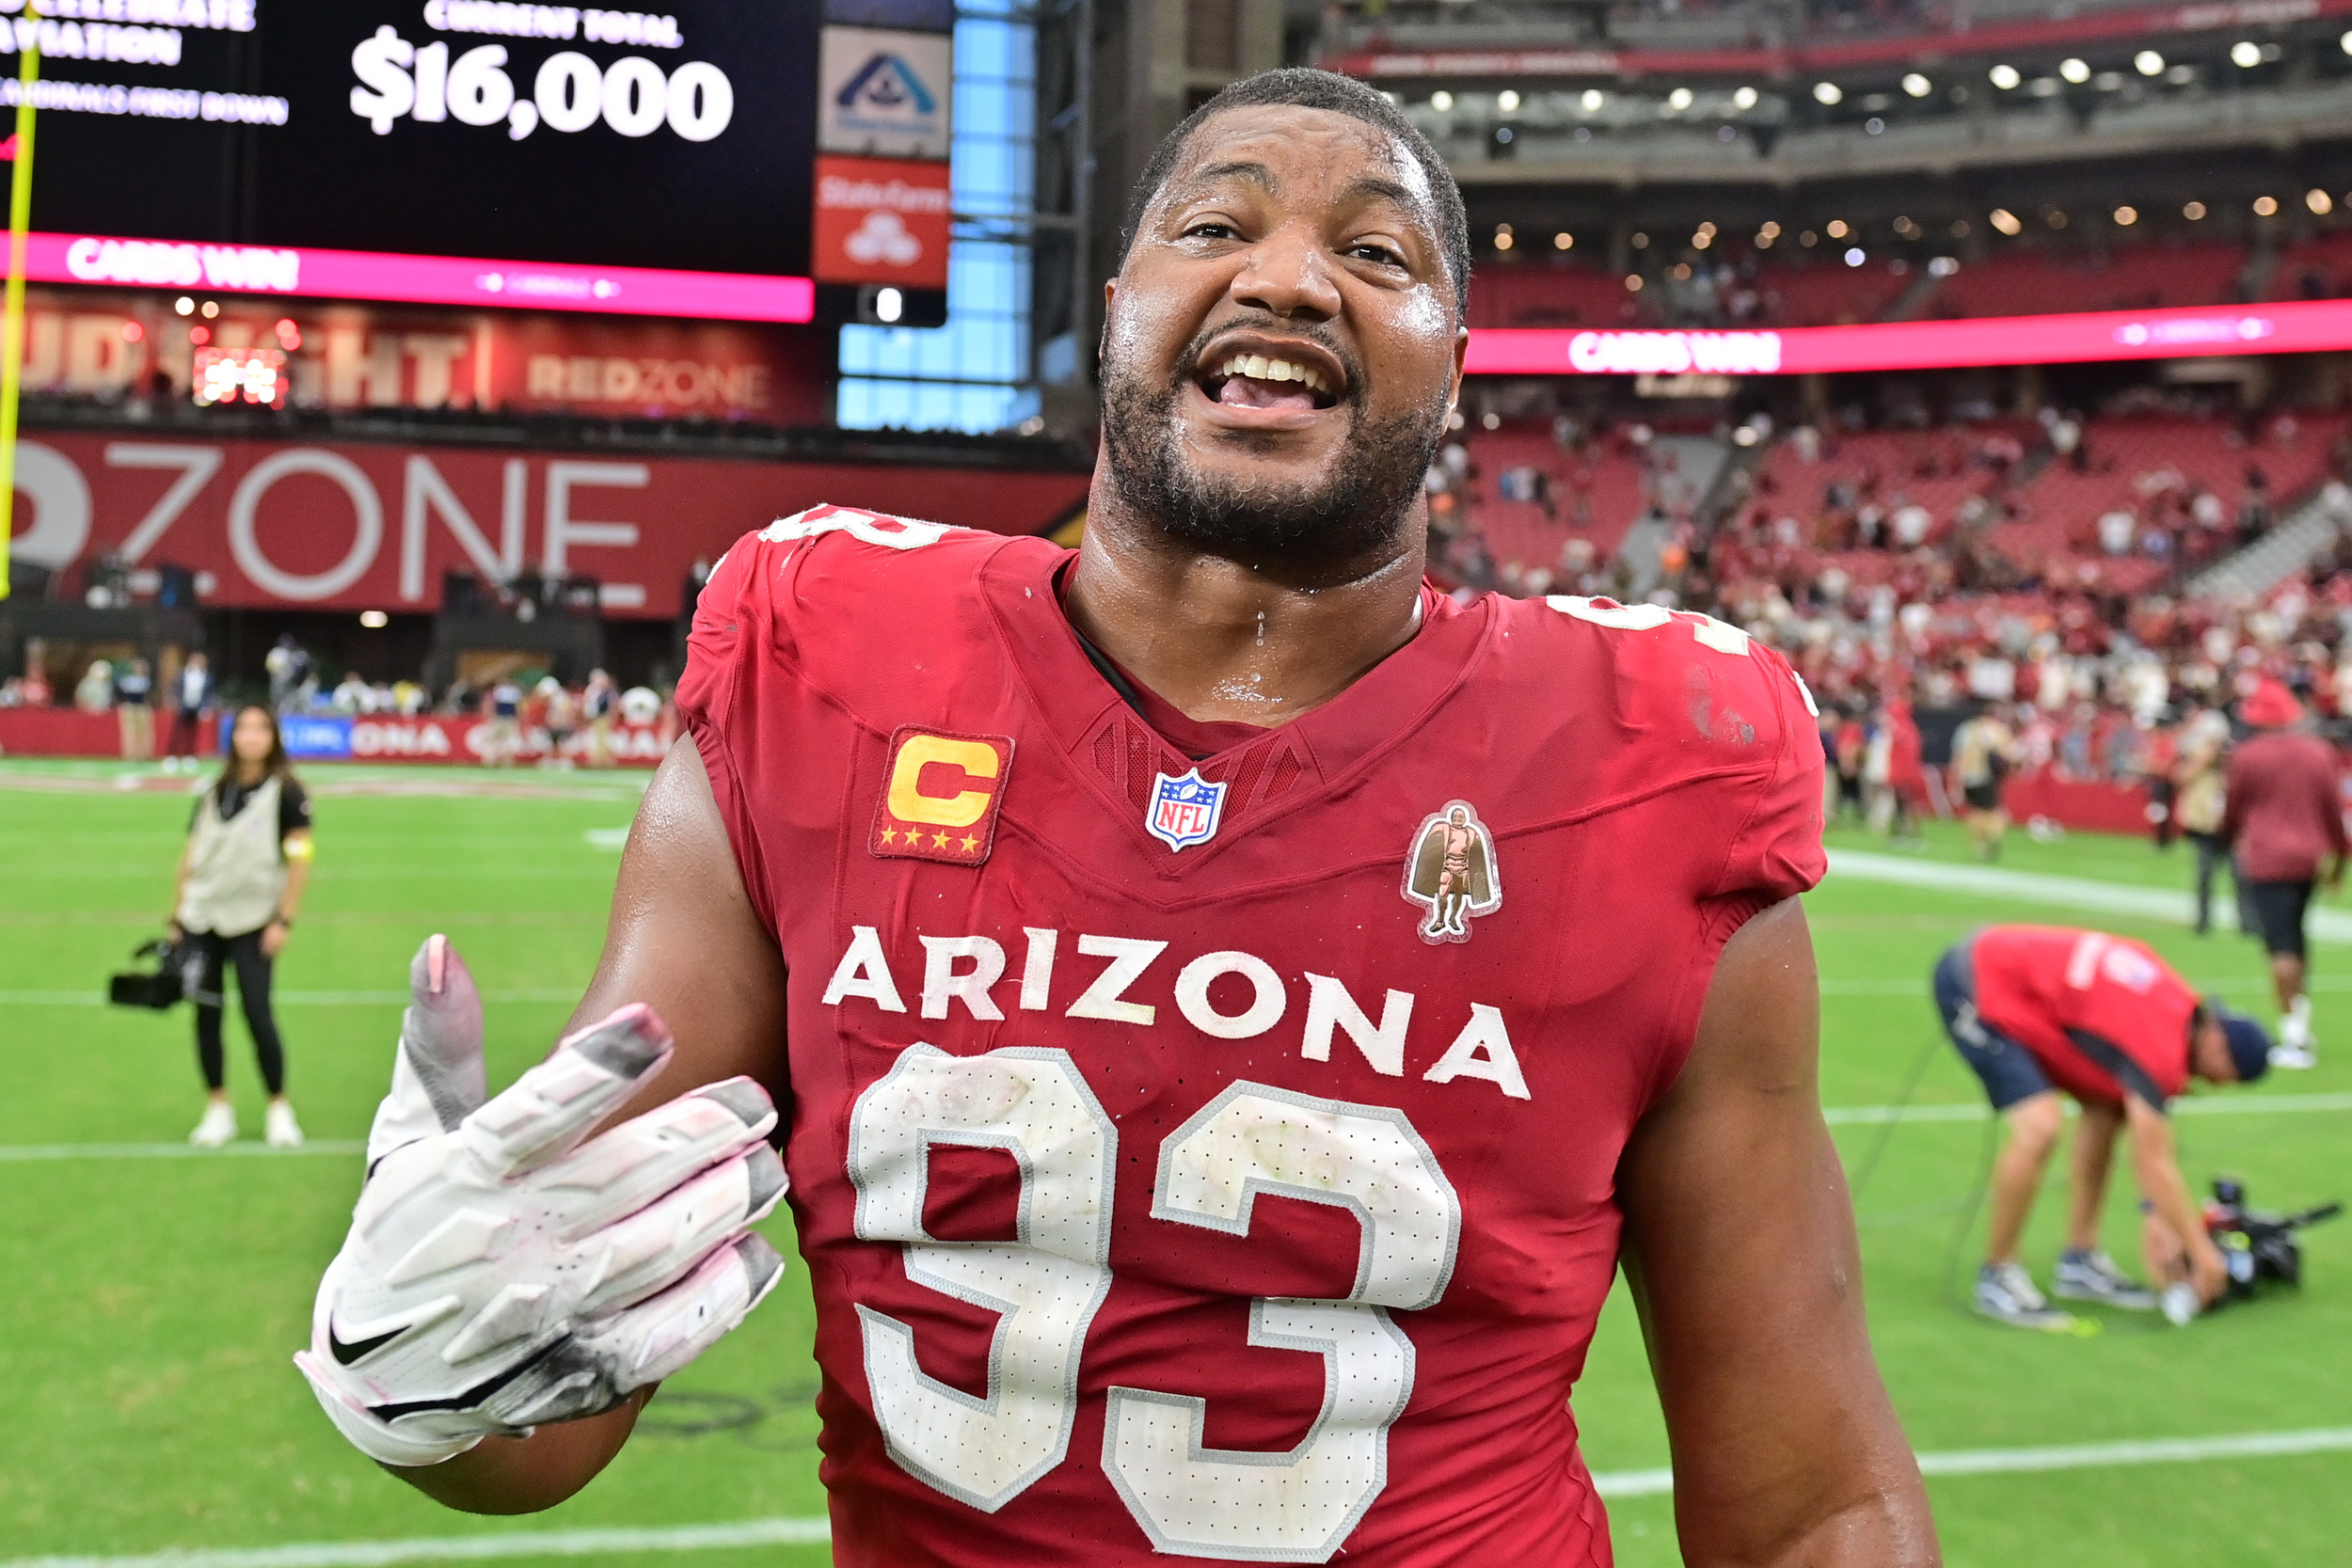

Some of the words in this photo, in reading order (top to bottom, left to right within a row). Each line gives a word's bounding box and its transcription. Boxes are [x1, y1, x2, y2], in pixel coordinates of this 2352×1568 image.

[423, 0, 577, 40] CURRENT
[583, 8, 685, 49] TOTAL
[350, 24, 734, 142] $16,000
[66, 237, 203, 286] CARDS
[162, 310, 469, 408] LHT
[1567, 331, 1692, 372] CARDS
[887, 735, 999, 828] C
[1158, 800, 1207, 835] NFL
[821, 925, 1531, 1101] ARIZONA
[849, 1041, 1462, 1564] 93
